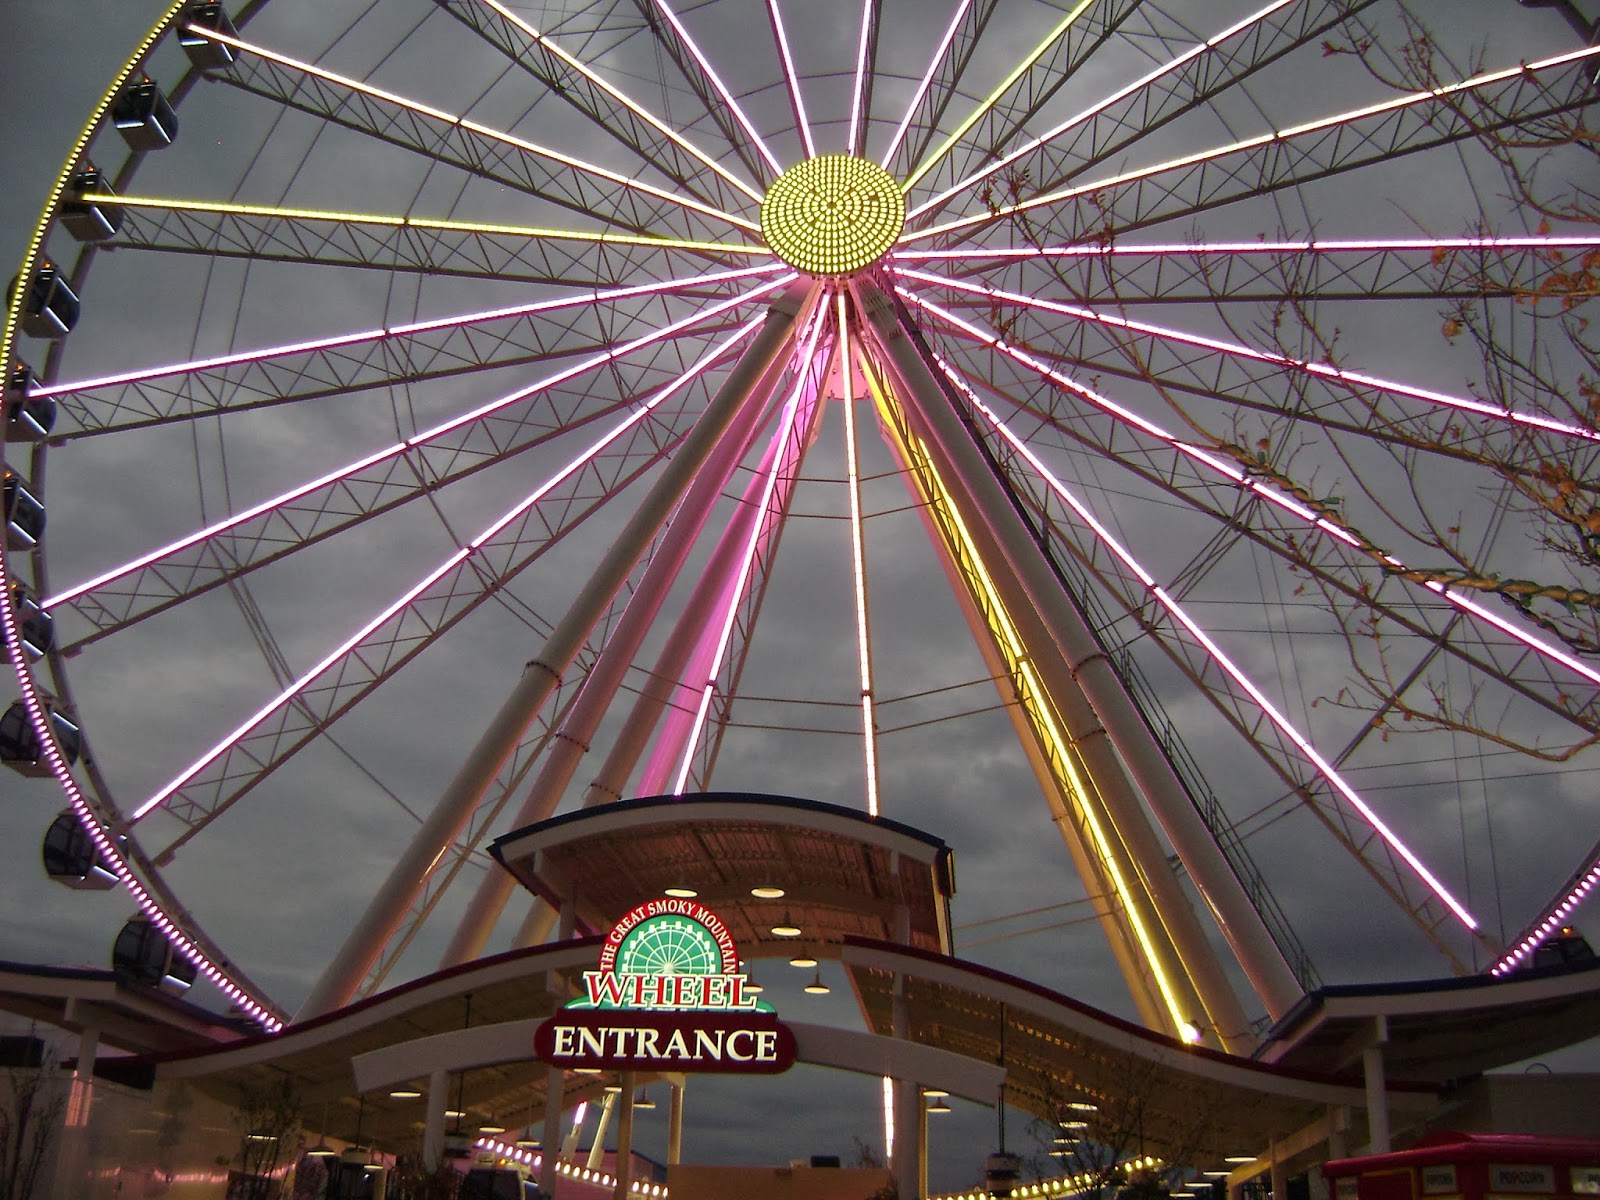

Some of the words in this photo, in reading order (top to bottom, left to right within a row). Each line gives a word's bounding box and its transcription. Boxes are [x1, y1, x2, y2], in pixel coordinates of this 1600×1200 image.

[600, 943, 617, 971] THE
[610, 907, 646, 943] GREAT
[648, 899, 696, 915] SMOKY
[695, 907, 736, 974] MOUNTAIN
[583, 971, 757, 1008] WHEEL
[553, 1026, 777, 1061] ENTRANCE
